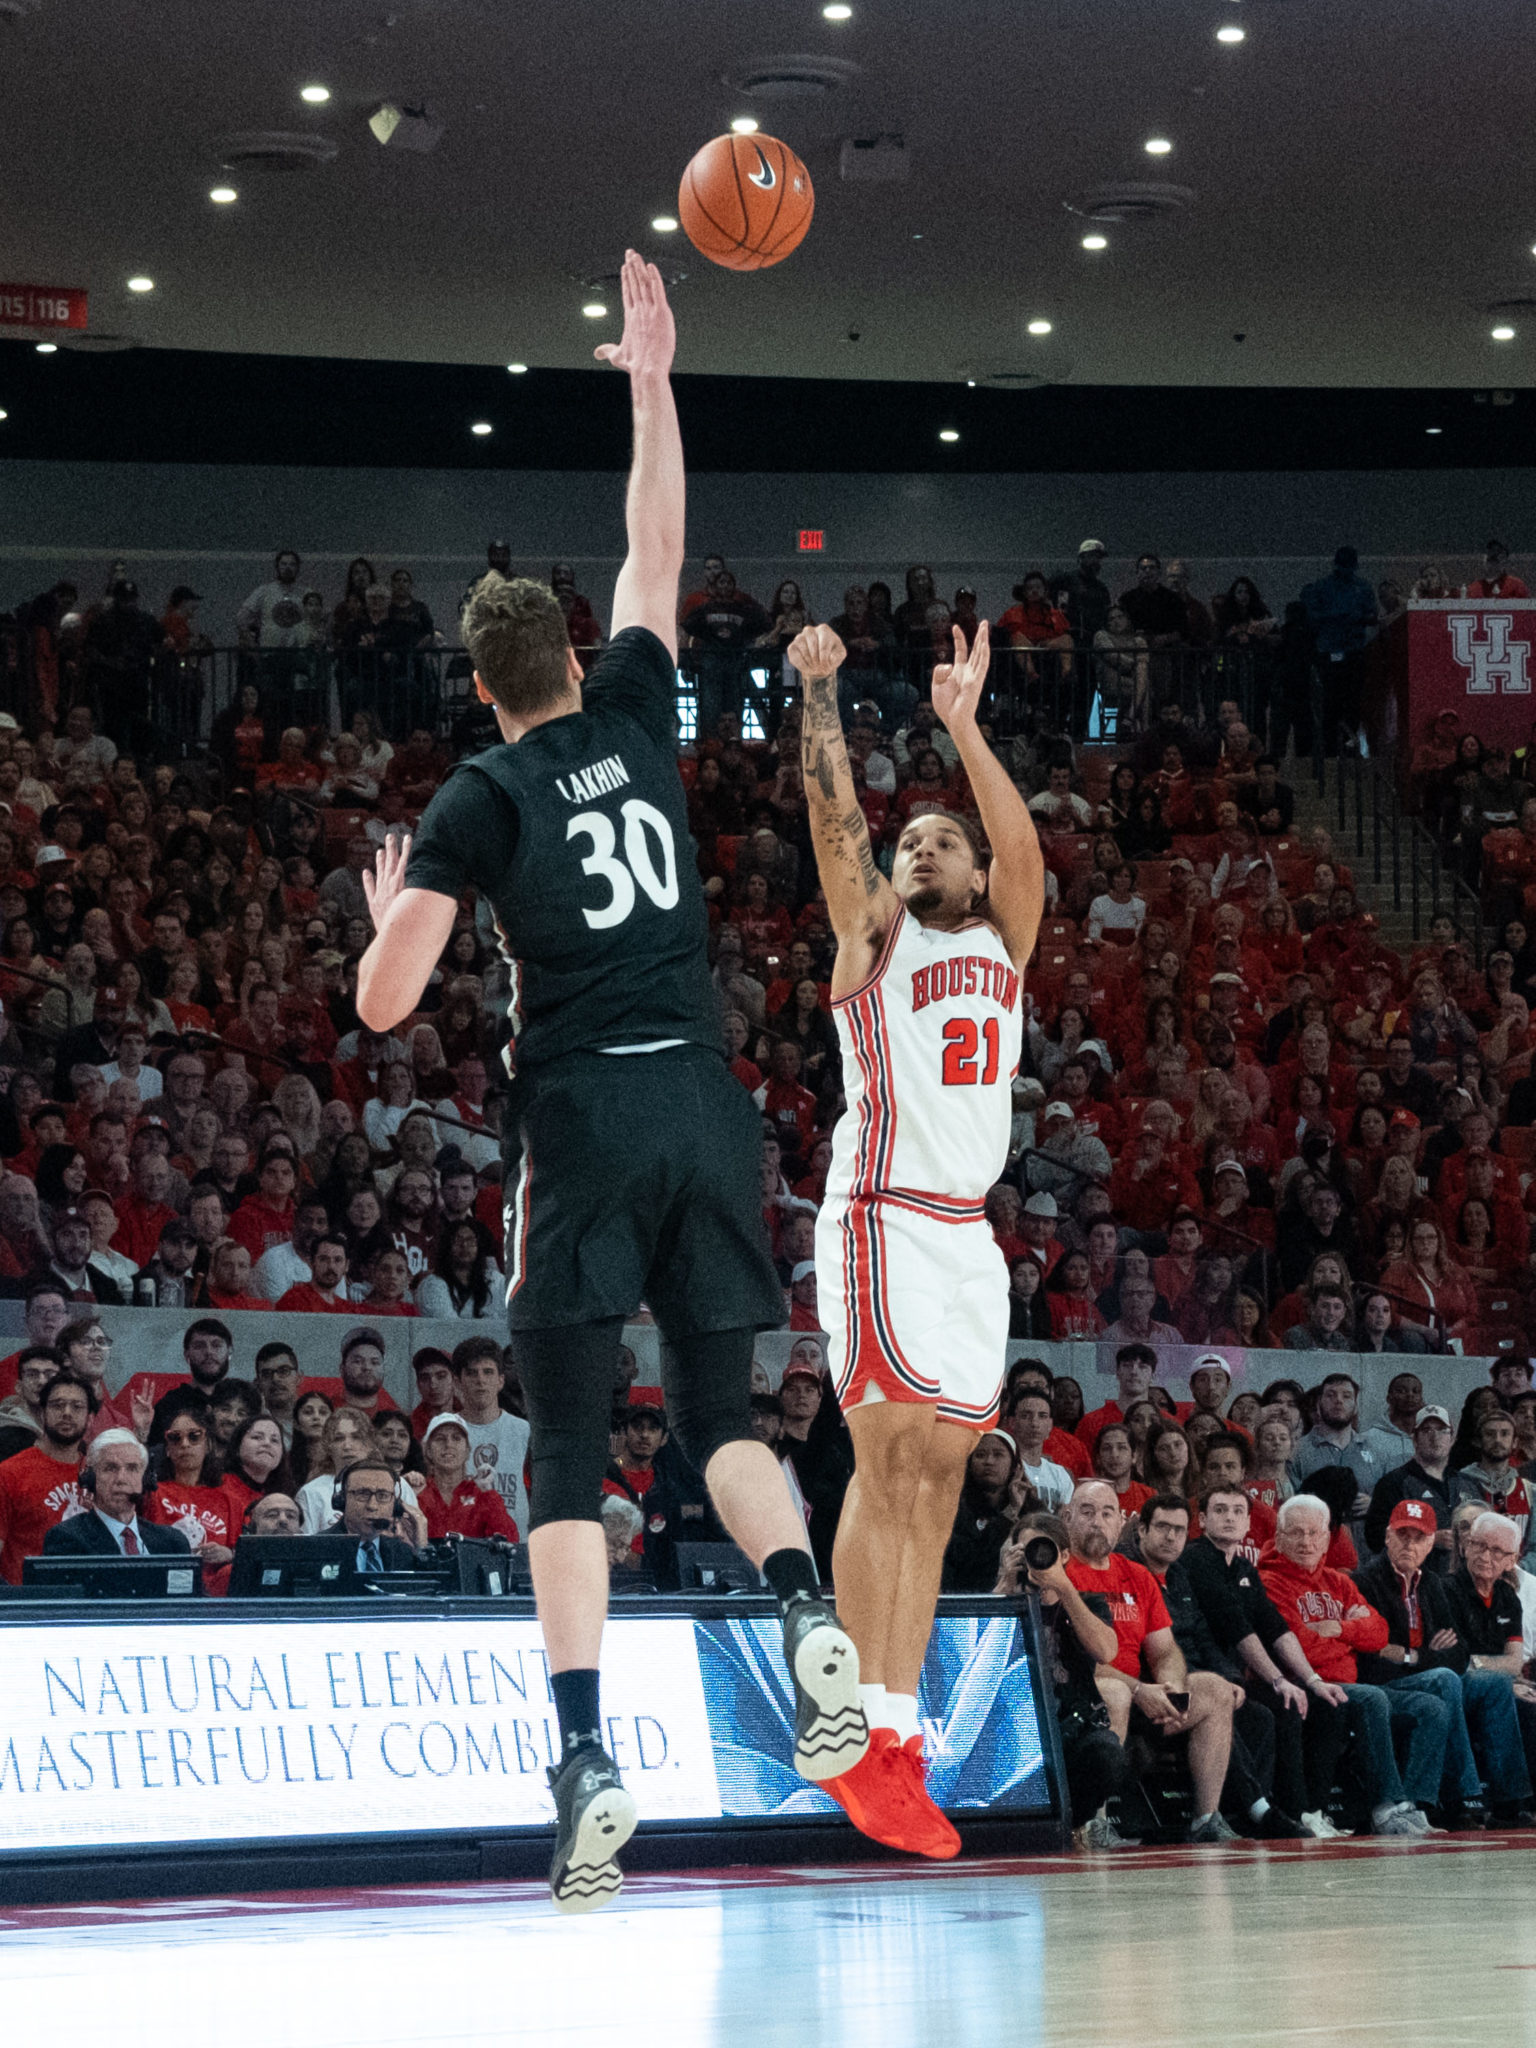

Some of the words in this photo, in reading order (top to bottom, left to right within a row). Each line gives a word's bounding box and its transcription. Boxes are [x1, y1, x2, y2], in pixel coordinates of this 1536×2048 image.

[799, 530, 823, 549] EXIT
[1447, 614, 1532, 694] UH
[555, 754, 631, 804] LAKHIN
[566, 798, 679, 929] 30
[912, 956, 1019, 1014] HOUSTON
[942, 1017, 999, 1086] 21
[44, 1481, 79, 1512] SPACE
[44, 1652, 309, 1716] NATURAL
[325, 1649, 557, 1708] ELEMENT
[0, 1723, 358, 1793] MASTERFULLY
[380, 1715, 681, 1778] COMBIED.
